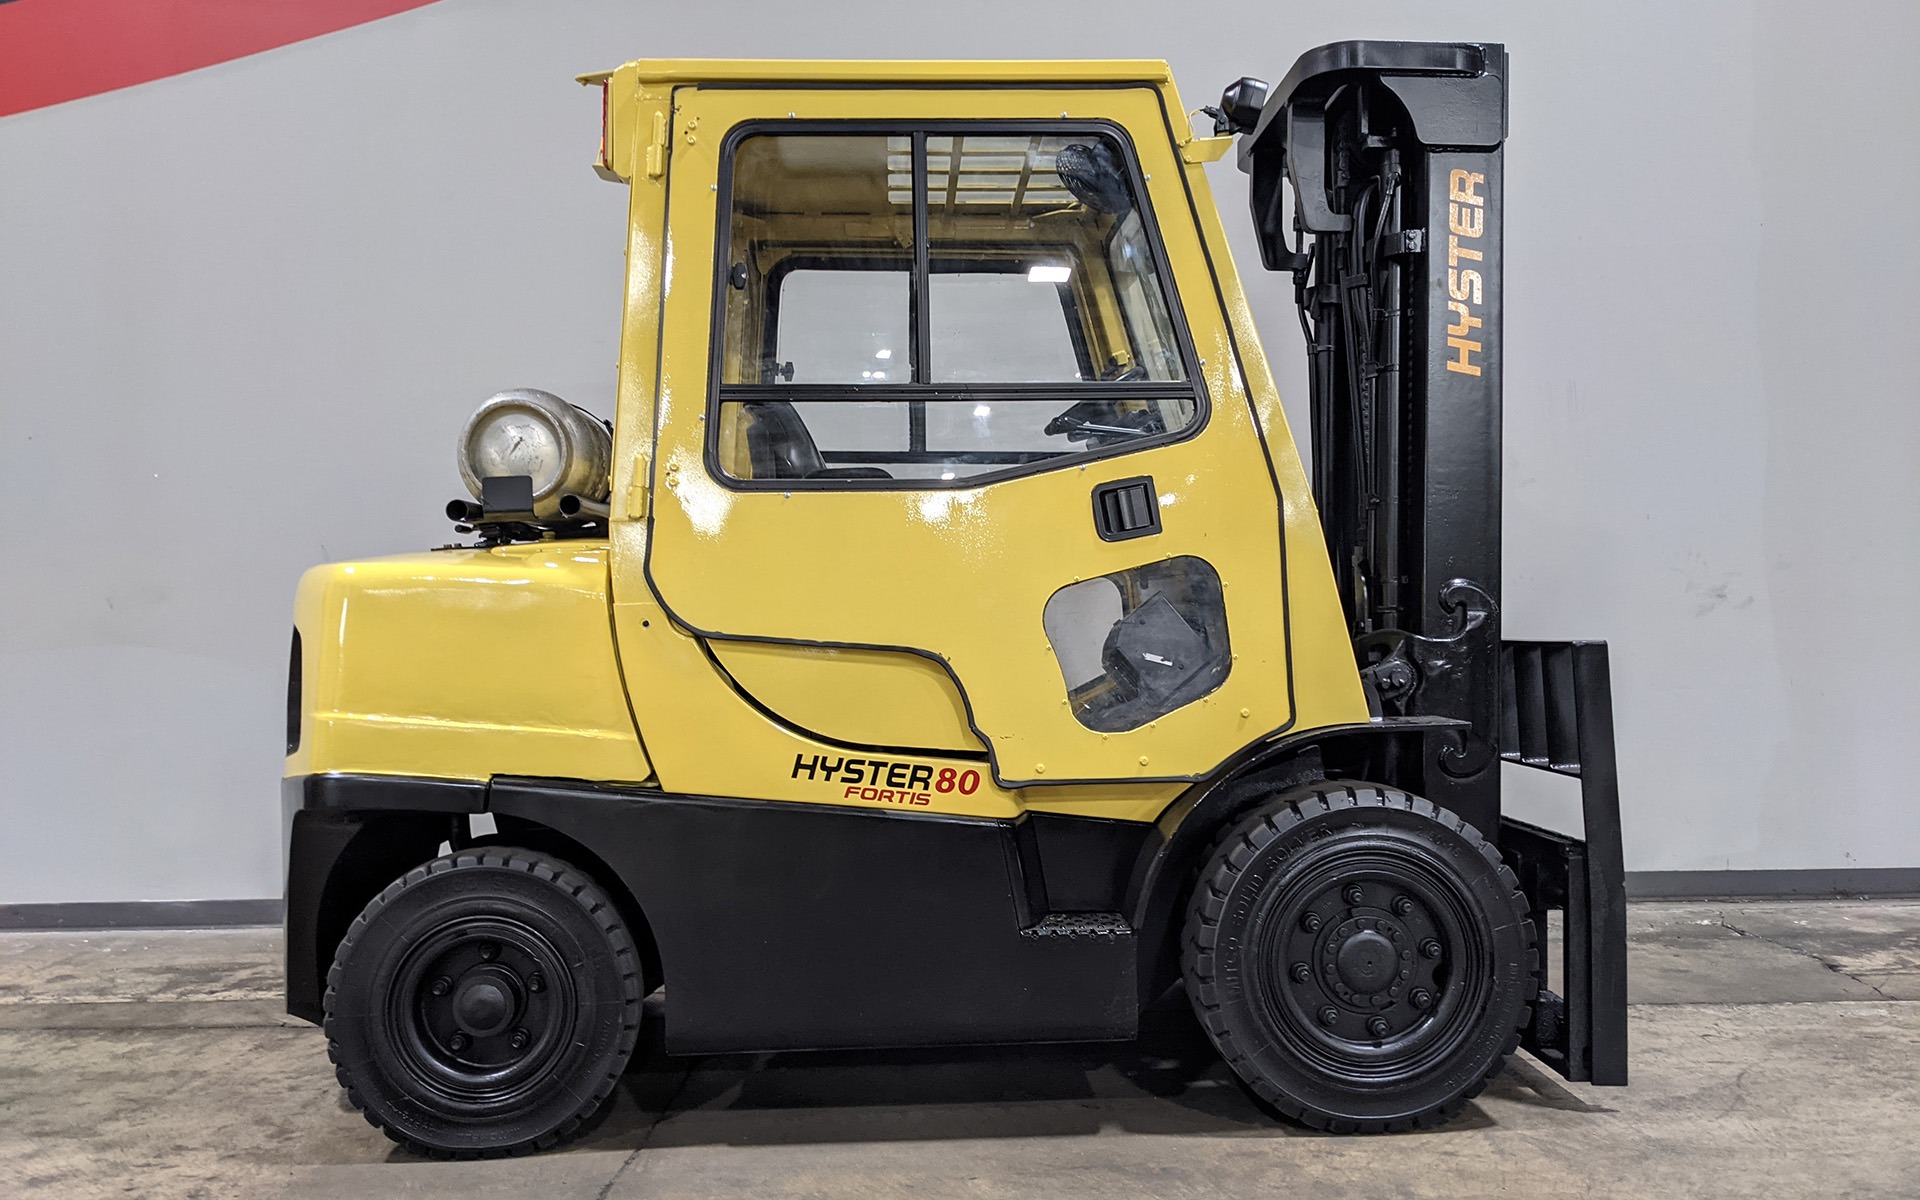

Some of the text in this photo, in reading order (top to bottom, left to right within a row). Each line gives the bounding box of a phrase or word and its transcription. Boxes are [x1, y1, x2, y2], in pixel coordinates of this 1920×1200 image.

[1447, 168, 1485, 377] HYSTER
[791, 753, 981, 795] HYSTER 80
[843, 786, 932, 806] FORTIS
